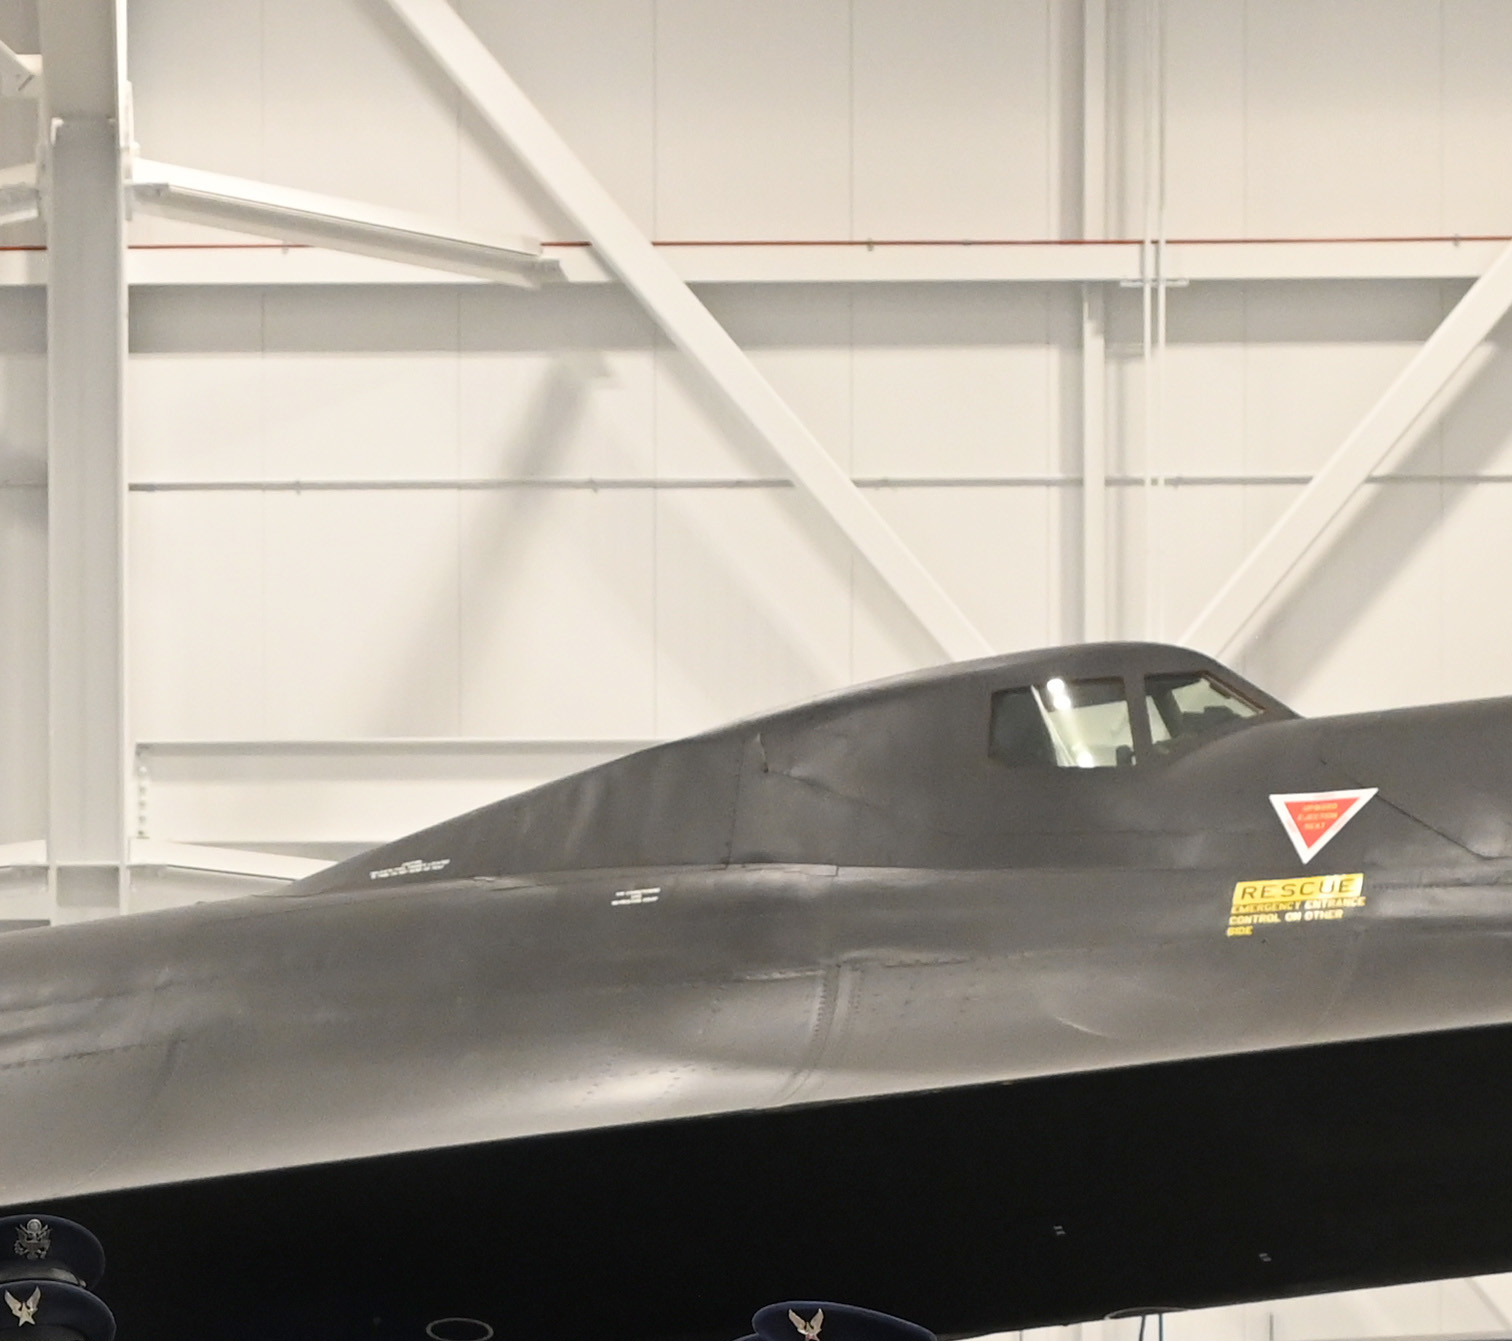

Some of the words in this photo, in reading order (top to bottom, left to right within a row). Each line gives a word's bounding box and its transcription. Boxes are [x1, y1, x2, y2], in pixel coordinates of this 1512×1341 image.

[1240, 878, 1355, 899] RESCUE
[1231, 901, 1302, 915] EMERGENCY
[1304, 897, 1366, 910] ENTRANCE
[1229, 912, 1281, 926] CONTROL
[1285, 911, 1302, 922] ON
[1304, 909, 1344, 921] OTHER
